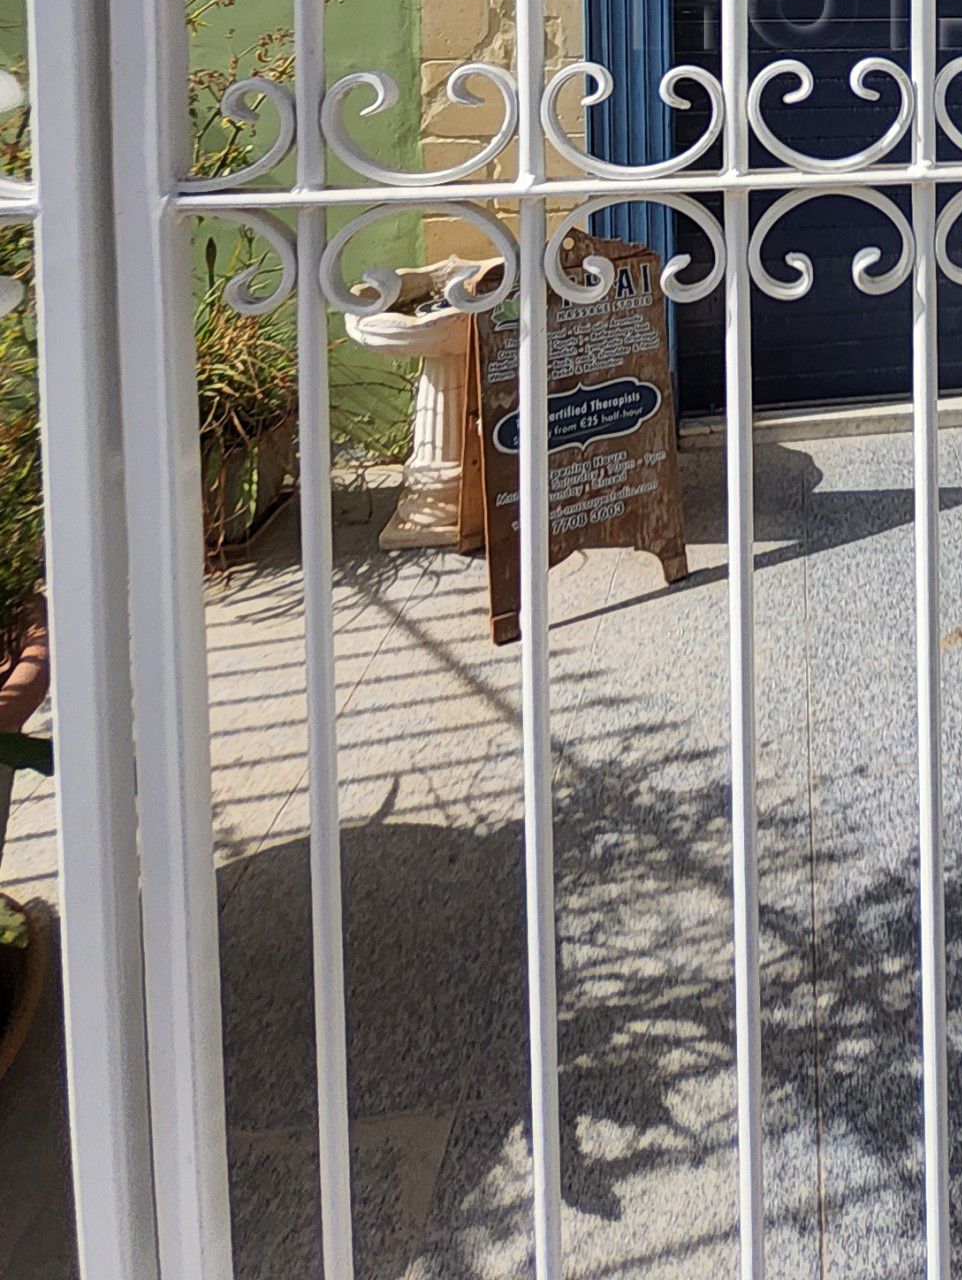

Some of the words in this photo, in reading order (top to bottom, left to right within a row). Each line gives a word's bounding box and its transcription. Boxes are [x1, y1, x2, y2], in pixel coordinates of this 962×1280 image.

[557, 303, 611, 322] MASSAGE
[548, 401, 588, 422] ertified
[590, 391, 641, 412] Therapists
[554, 423, 578, 437] from
[580, 415, 599, 429] €25
[549, 461, 592, 480] pening
[548, 484, 583, 503] unday
